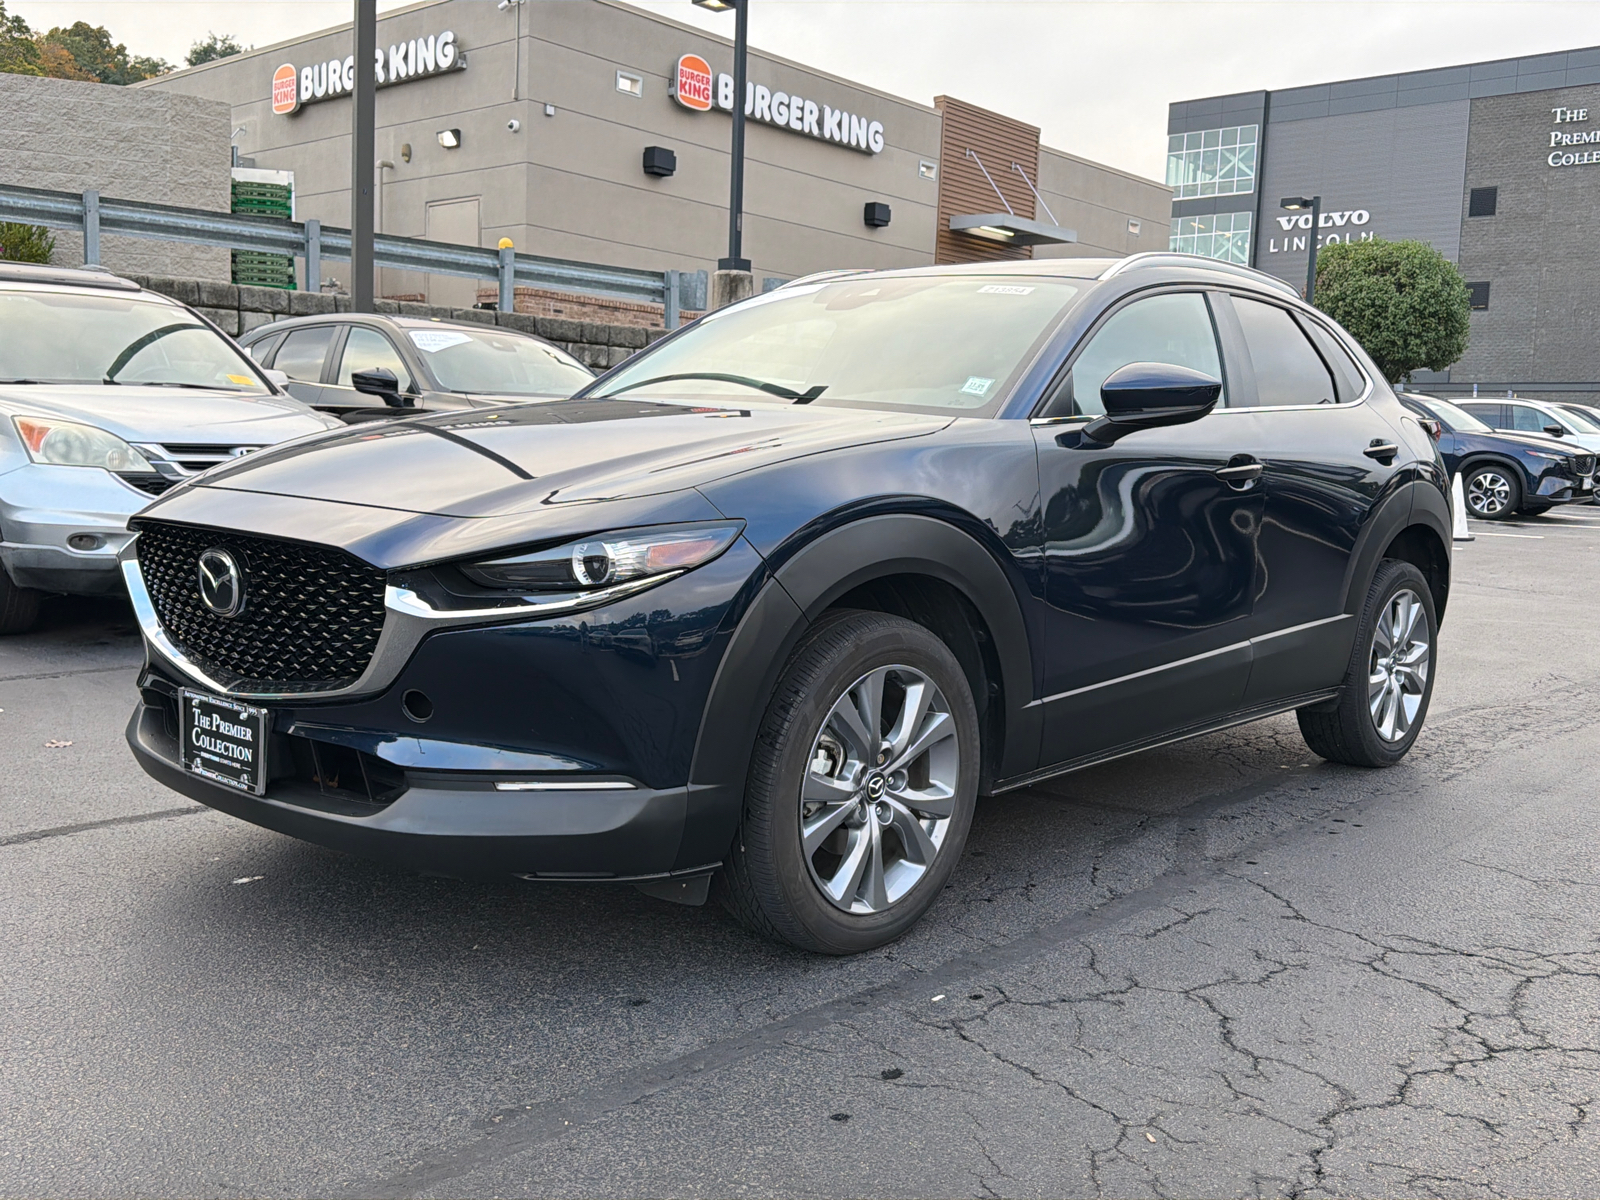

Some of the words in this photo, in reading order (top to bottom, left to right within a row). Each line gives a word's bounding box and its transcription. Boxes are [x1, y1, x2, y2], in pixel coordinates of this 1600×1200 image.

[301, 48, 385, 101] BURGR
[389, 31, 456, 80] KING
[274, 78, 295, 92] BURGER
[679, 68, 711, 87] BURGER
[274, 89, 295, 105] KING
[679, 79, 711, 101] KING
[823, 104, 885, 153] KING
[1276, 209, 1370, 231] VOLVO
[211, 713, 253, 741] PREMIER
[192, 727, 253, 762] COLLECTION
